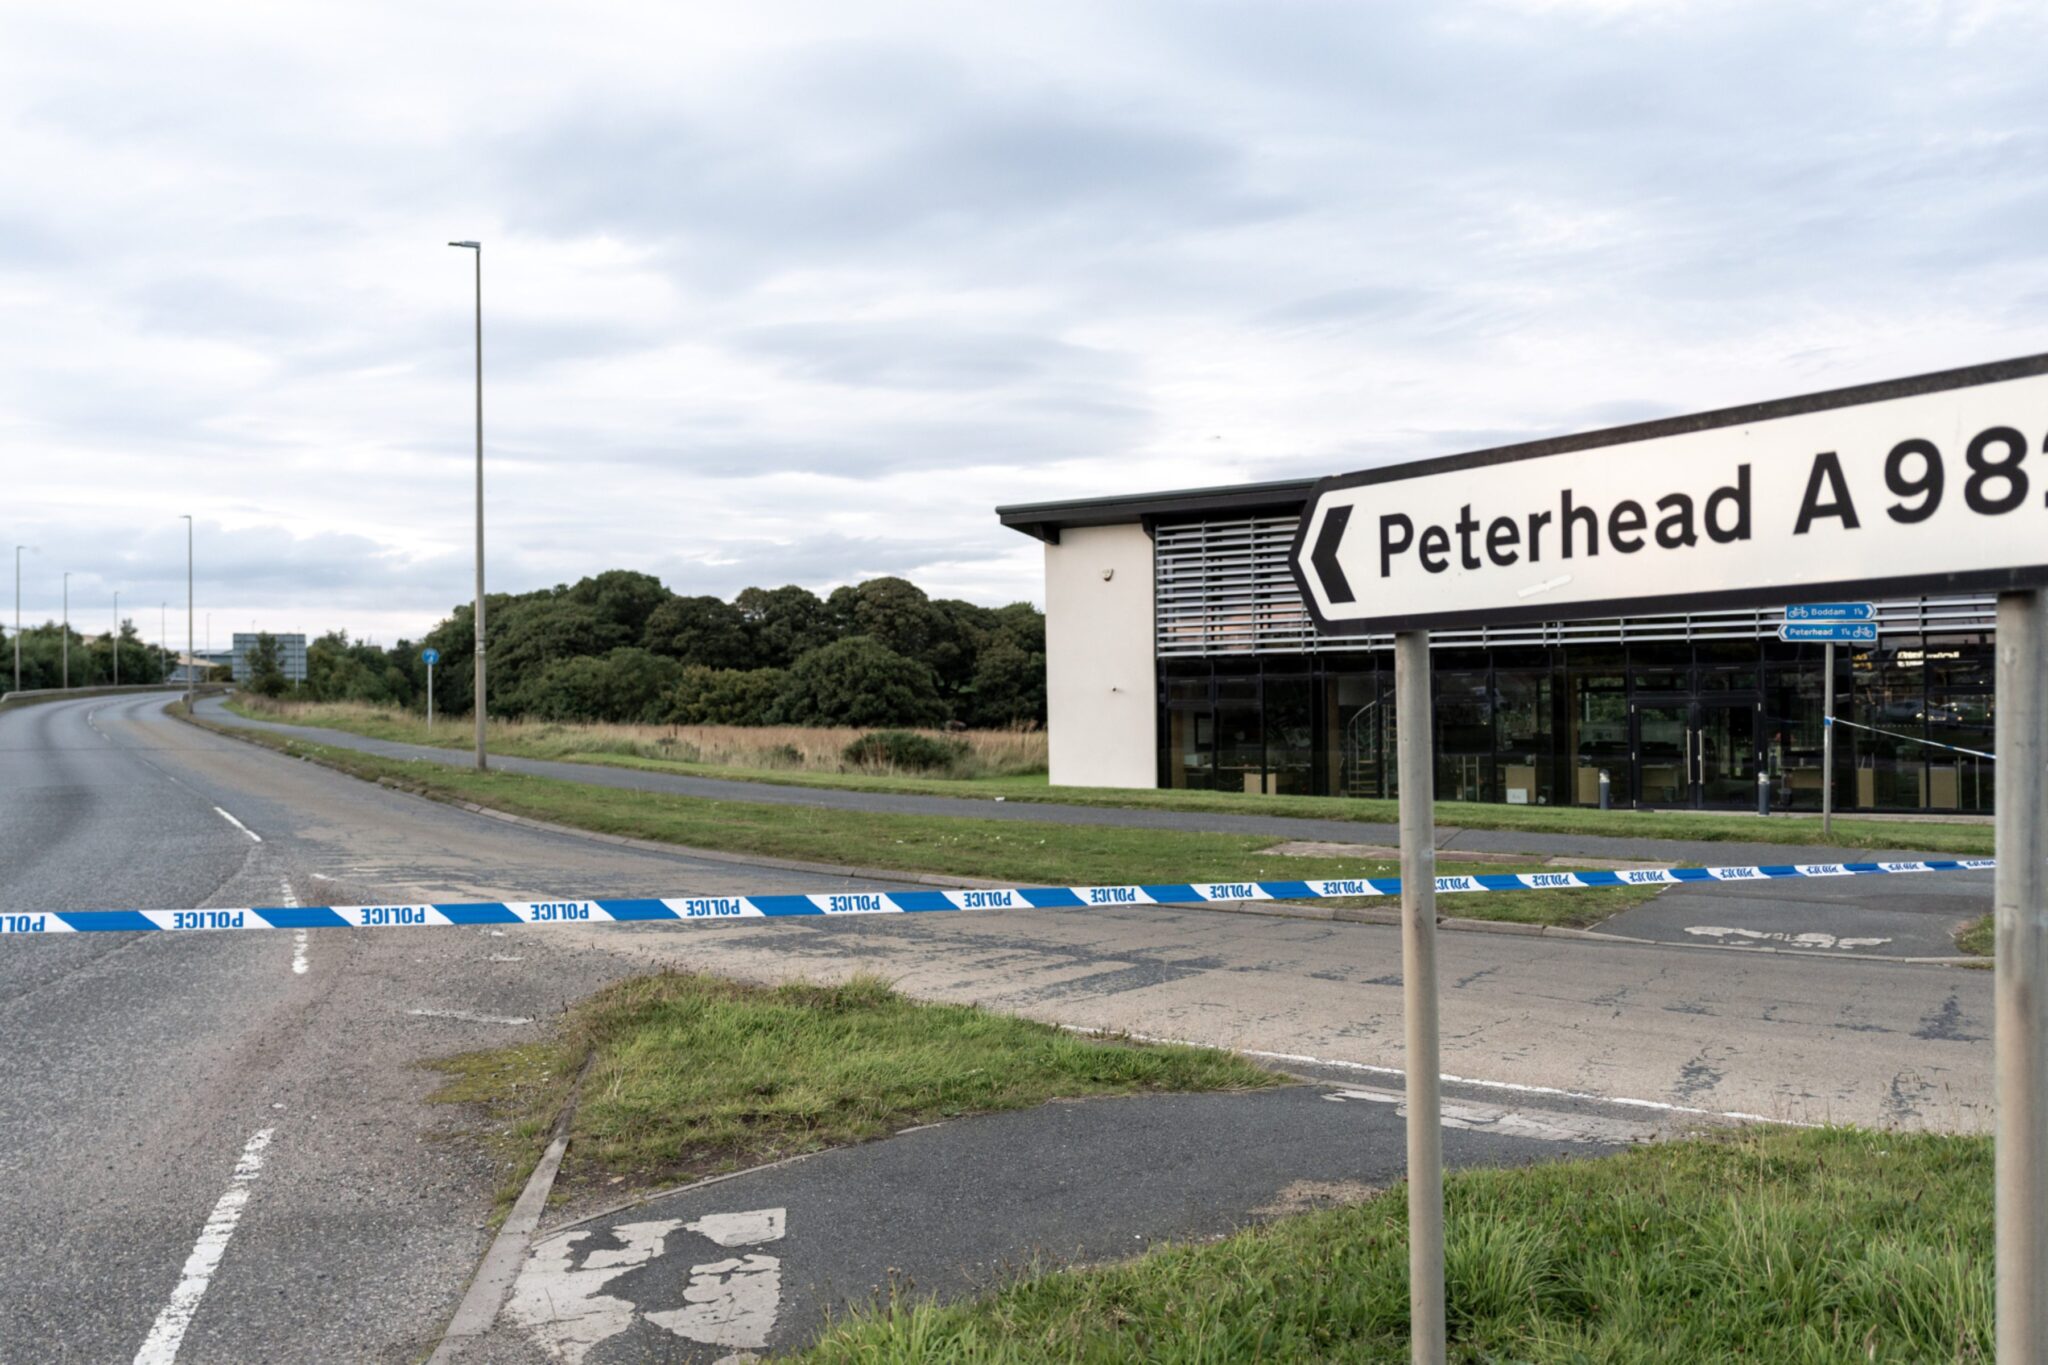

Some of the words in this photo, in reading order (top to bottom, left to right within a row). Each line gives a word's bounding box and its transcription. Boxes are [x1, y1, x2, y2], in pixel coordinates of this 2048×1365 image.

[1378, 463, 1752, 579] Peterhead
[1792, 424, 2048, 536] A98
[1811, 608, 1846, 616] Boddam
[1789, 628, 1833, 636] Peterhead
[173, 909, 244, 929] POLICE
[361, 907, 426, 925] POLICE
[530, 903, 589, 920] POLICE
[686, 899, 740, 916] POLICE
[829, 894, 881, 912] POLICE
[964, 891, 1012, 908] POLICE
[1091, 887, 1136, 903] POLICE
[1210, 883, 1253, 899] POLICE
[1323, 880, 1365, 895] POLICE
[1435, 877, 1470, 890] POLIC
[1532, 874, 1570, 887] POLICE
[1629, 869, 1665, 883] POLICE
